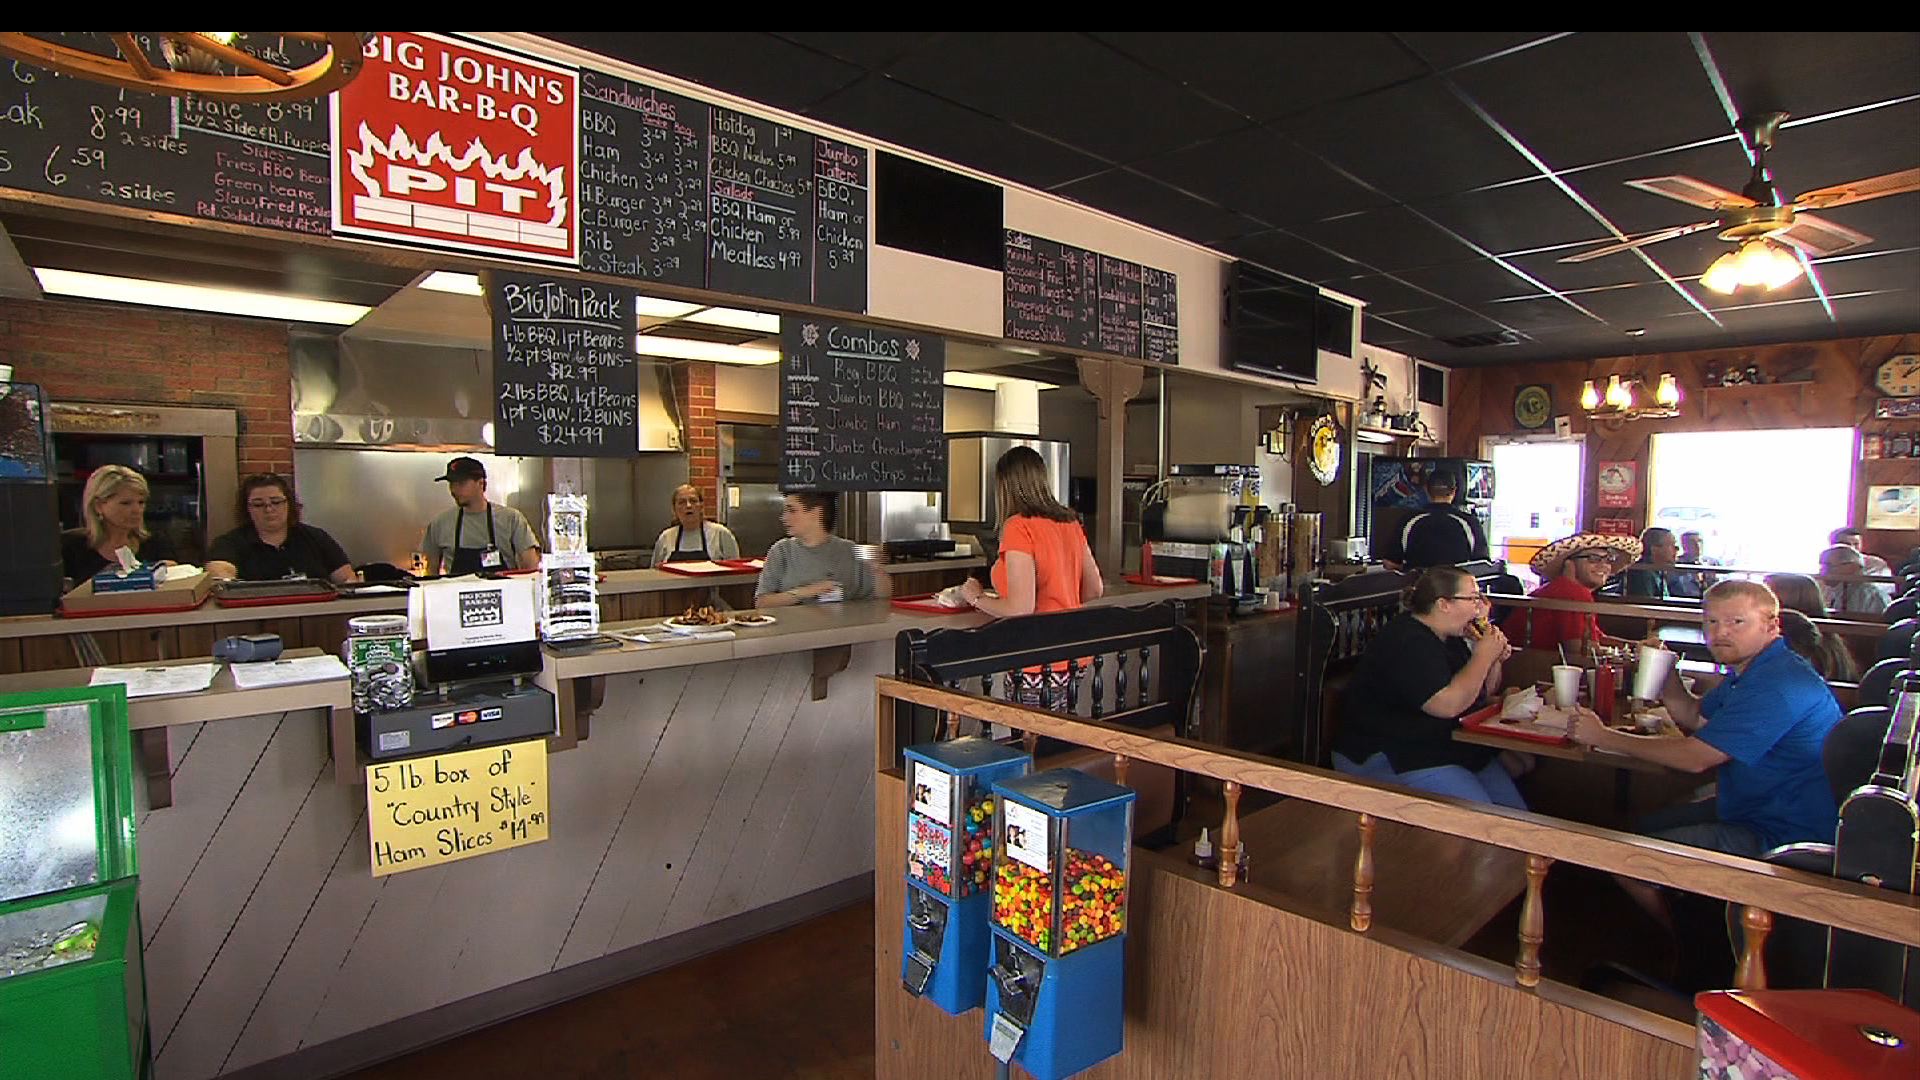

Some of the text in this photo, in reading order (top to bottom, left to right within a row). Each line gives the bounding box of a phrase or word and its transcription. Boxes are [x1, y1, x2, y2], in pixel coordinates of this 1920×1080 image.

[363, 35, 564, 105] BIG JOHN'S
[388, 71, 539, 137] BAR-B-Q
[581, 73, 676, 120] Sandwiches
[0, 92, 44, 129] ak
[583, 109, 617, 136] BBQ
[583, 135, 621, 162] Ham
[712, 134, 740, 158] BBQ
[818, 138, 858, 167] Jumbo
[214, 171, 263, 193] Green
[581, 160, 639, 190] Chicken
[815, 159, 858, 185] Taters
[387, 163, 539, 214] PIT
[713, 180, 756, 202] Salads
[746, 203, 777, 227] Ham
[818, 201, 848, 225] Ham
[584, 228, 613, 252] Rib
[711, 217, 765, 244] Chicken
[817, 224, 864, 250] Chicken
[711, 239, 776, 270] Meatless
[581, 287, 623, 320] Pack
[583, 329, 624, 349] Beans
[827, 326, 900, 357] Combos
[548, 362, 598, 383] $12.99
[866, 361, 898, 385] BBQ
[598, 386, 637, 408] Beans
[878, 388, 904, 409] BBQ
[594, 408, 632, 426] BUNS
[374, 766, 390, 793] 5
[434, 760, 470, 784] box
[488, 749, 511, 777] of
[374, 841, 426, 866] Ham
[436, 827, 493, 856] Slices
